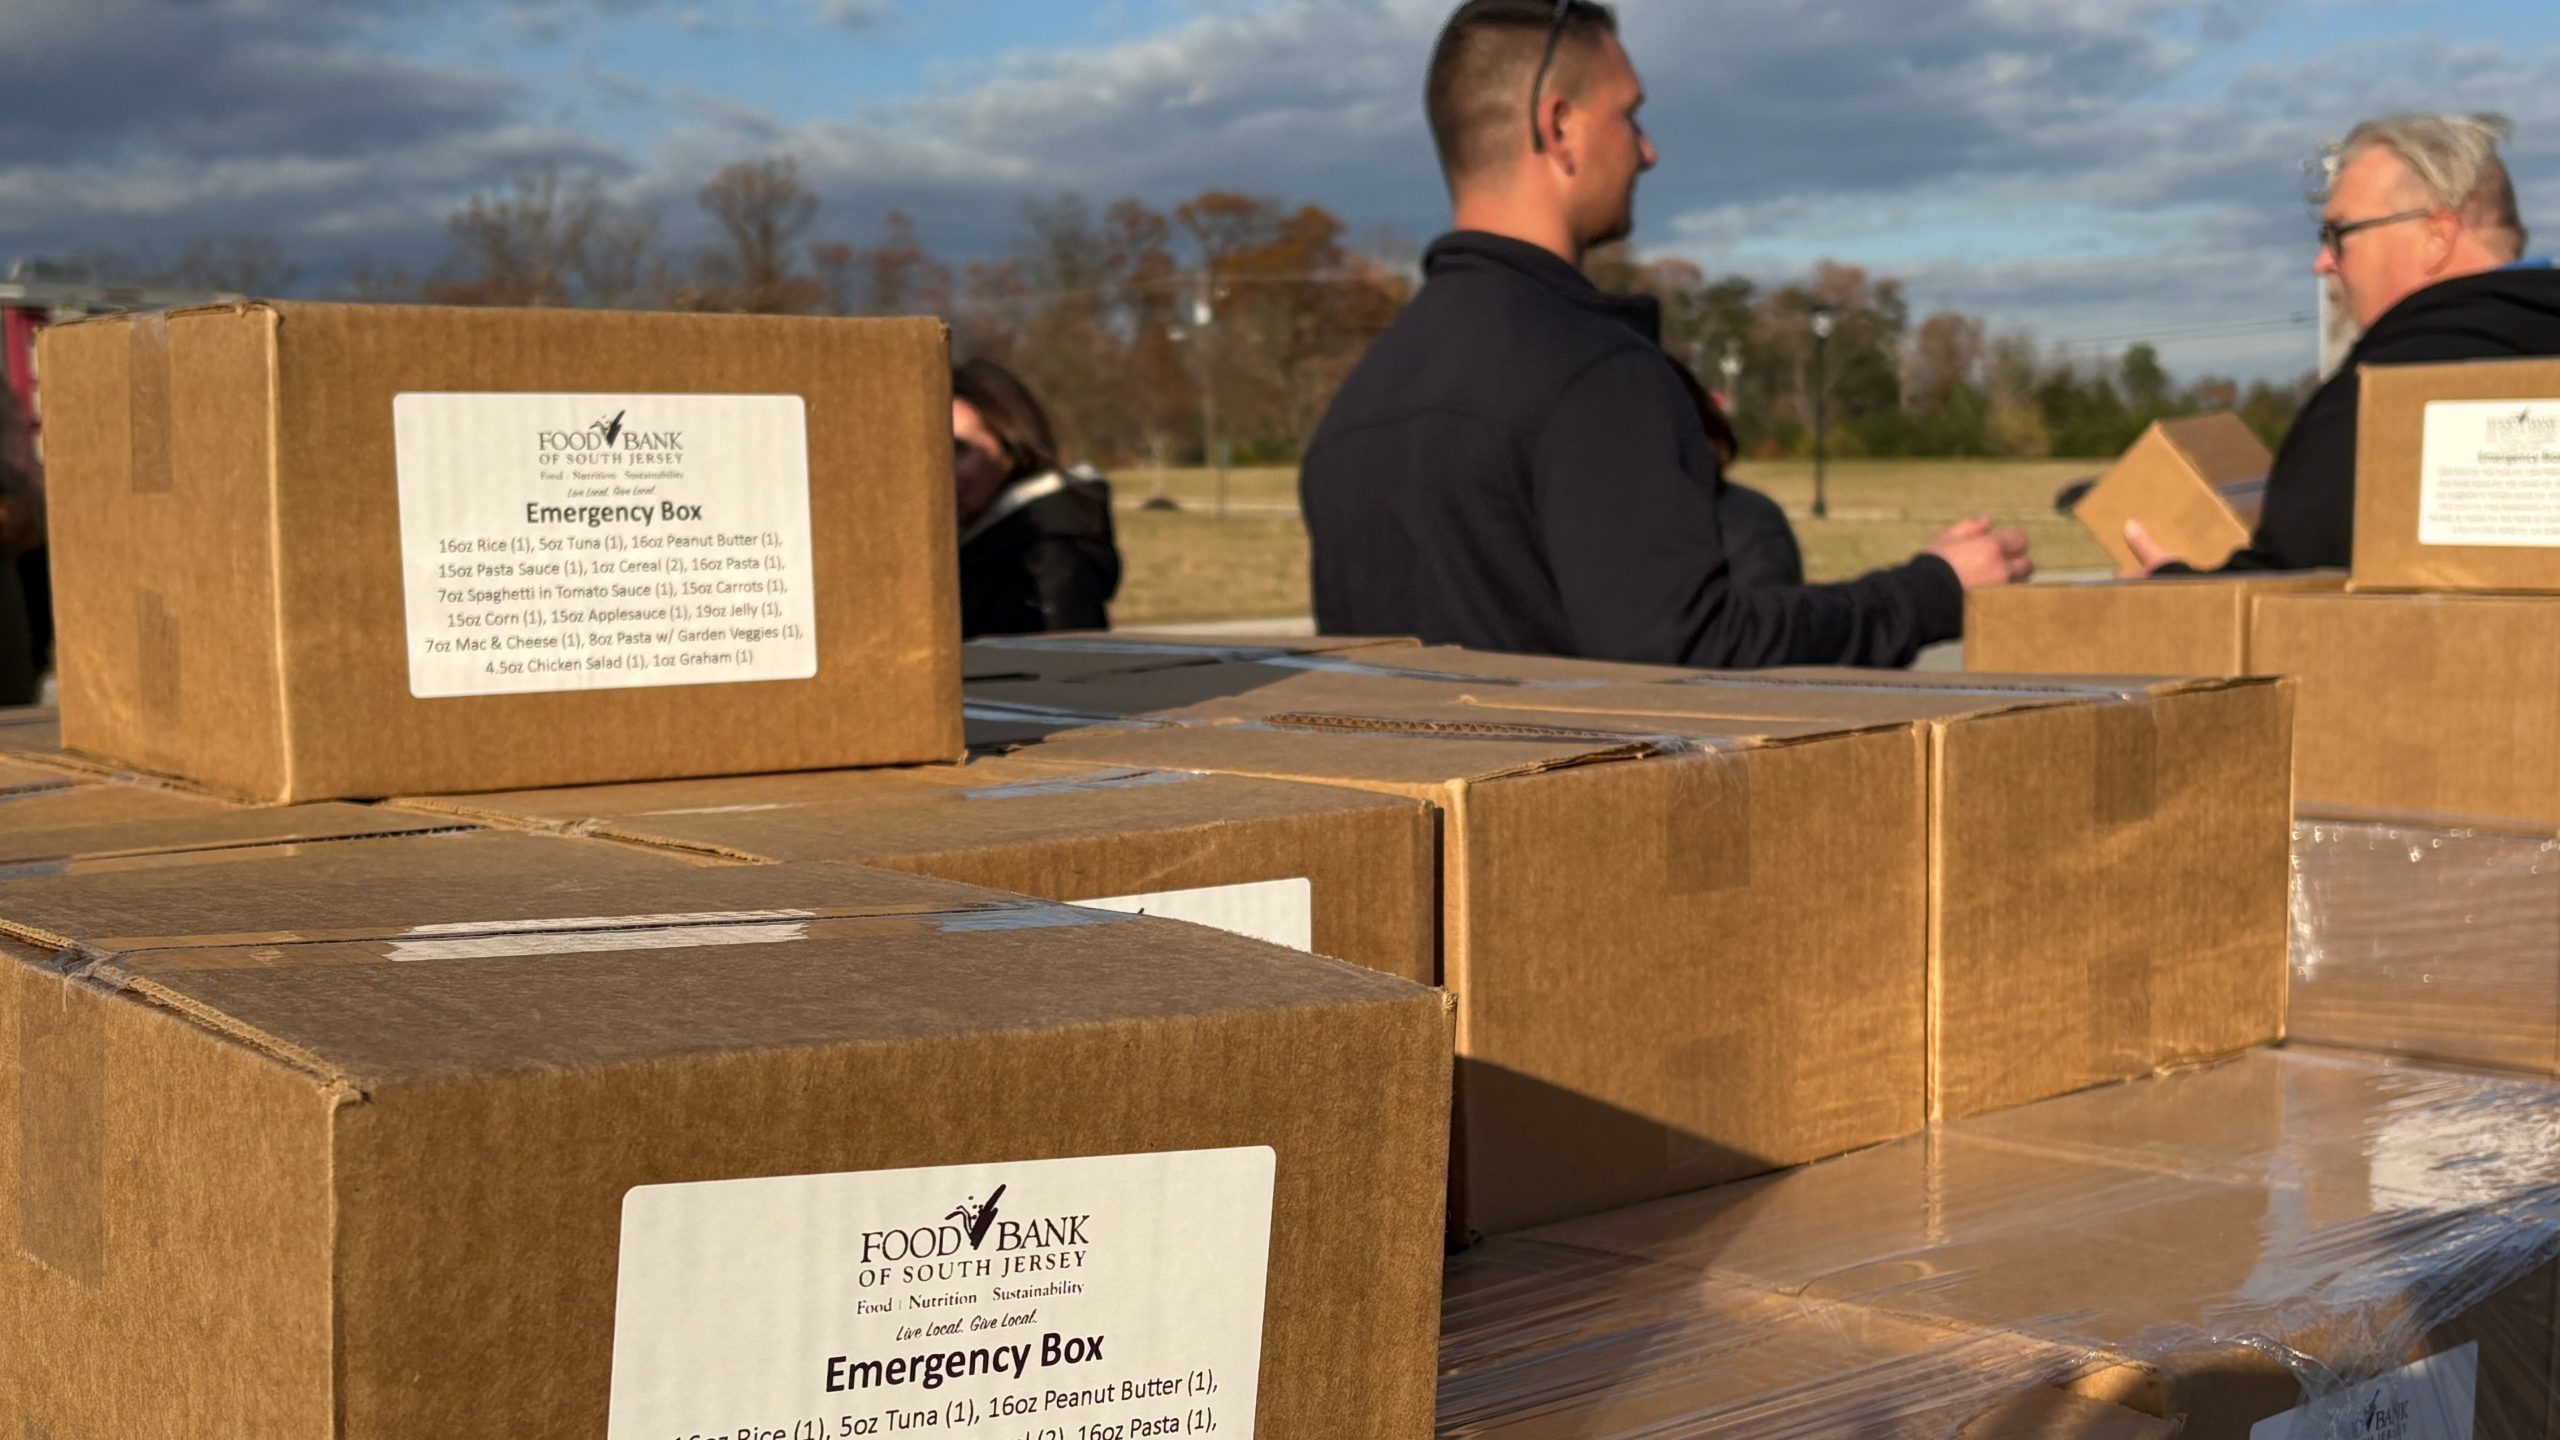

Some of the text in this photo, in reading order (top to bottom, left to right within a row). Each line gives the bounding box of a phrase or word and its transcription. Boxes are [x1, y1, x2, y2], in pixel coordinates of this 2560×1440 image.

[538, 431, 684, 451] FOOD BANK
[538, 452, 684, 466] OF SOUTH JERSEY
[526, 500, 702, 528] Emergency Box
[438, 532, 783, 554] 16oz Rice (1), 5oz Tuna (1), 16oz Peanut Butter (1),
[438, 555, 785, 579] 15oz Pasta Sauce (1), 1oz Cereal (2), 16oz Pasta (1),
[437, 578, 788, 605] 7oz Spaghetti in Tomato Sauce (1), 15oz Carrots (1),
[447, 602, 783, 628] 15oz Corn (1), 15oz Applesauce (1), 19oz Jelly (1),
[425, 624, 804, 654] 7oz Mac & Cheese (1), 8oz Pasta w/ Garden Veggies (1),
[485, 649, 754, 675] 4.5oz Chicken Salad (1), 1oz Graham (1)
[860, 1214, 1091, 1264] FOOD BANK
[858, 1250, 1088, 1288] OF SOUTH JERSEY
[856, 1279, 1086, 1315] Food Nutrition Sustainability
[895, 1325, 922, 1342] Live
[926, 1318, 965, 1338] Local.
[970, 1314, 998, 1333] Give
[825, 1332, 1106, 1392] Emergency Box
[794, 1417, 831, 1440] (1),
[839, 1415, 879, 1438] 5oz
[885, 1409, 939, 1432] Tuna
[945, 1400, 981, 1429] (1),
[988, 1395, 1038, 1419] 16oz
[1044, 1383, 1116, 1411] Peanut
[1121, 1377, 1184, 1401] Butter
[1187, 1368, 1219, 1397] (1),
[1078, 1424, 1124, 1440] 16oz
[1130, 1415, 1180, 1439] Pasta
[1187, 1407, 1218, 1436] (1),
